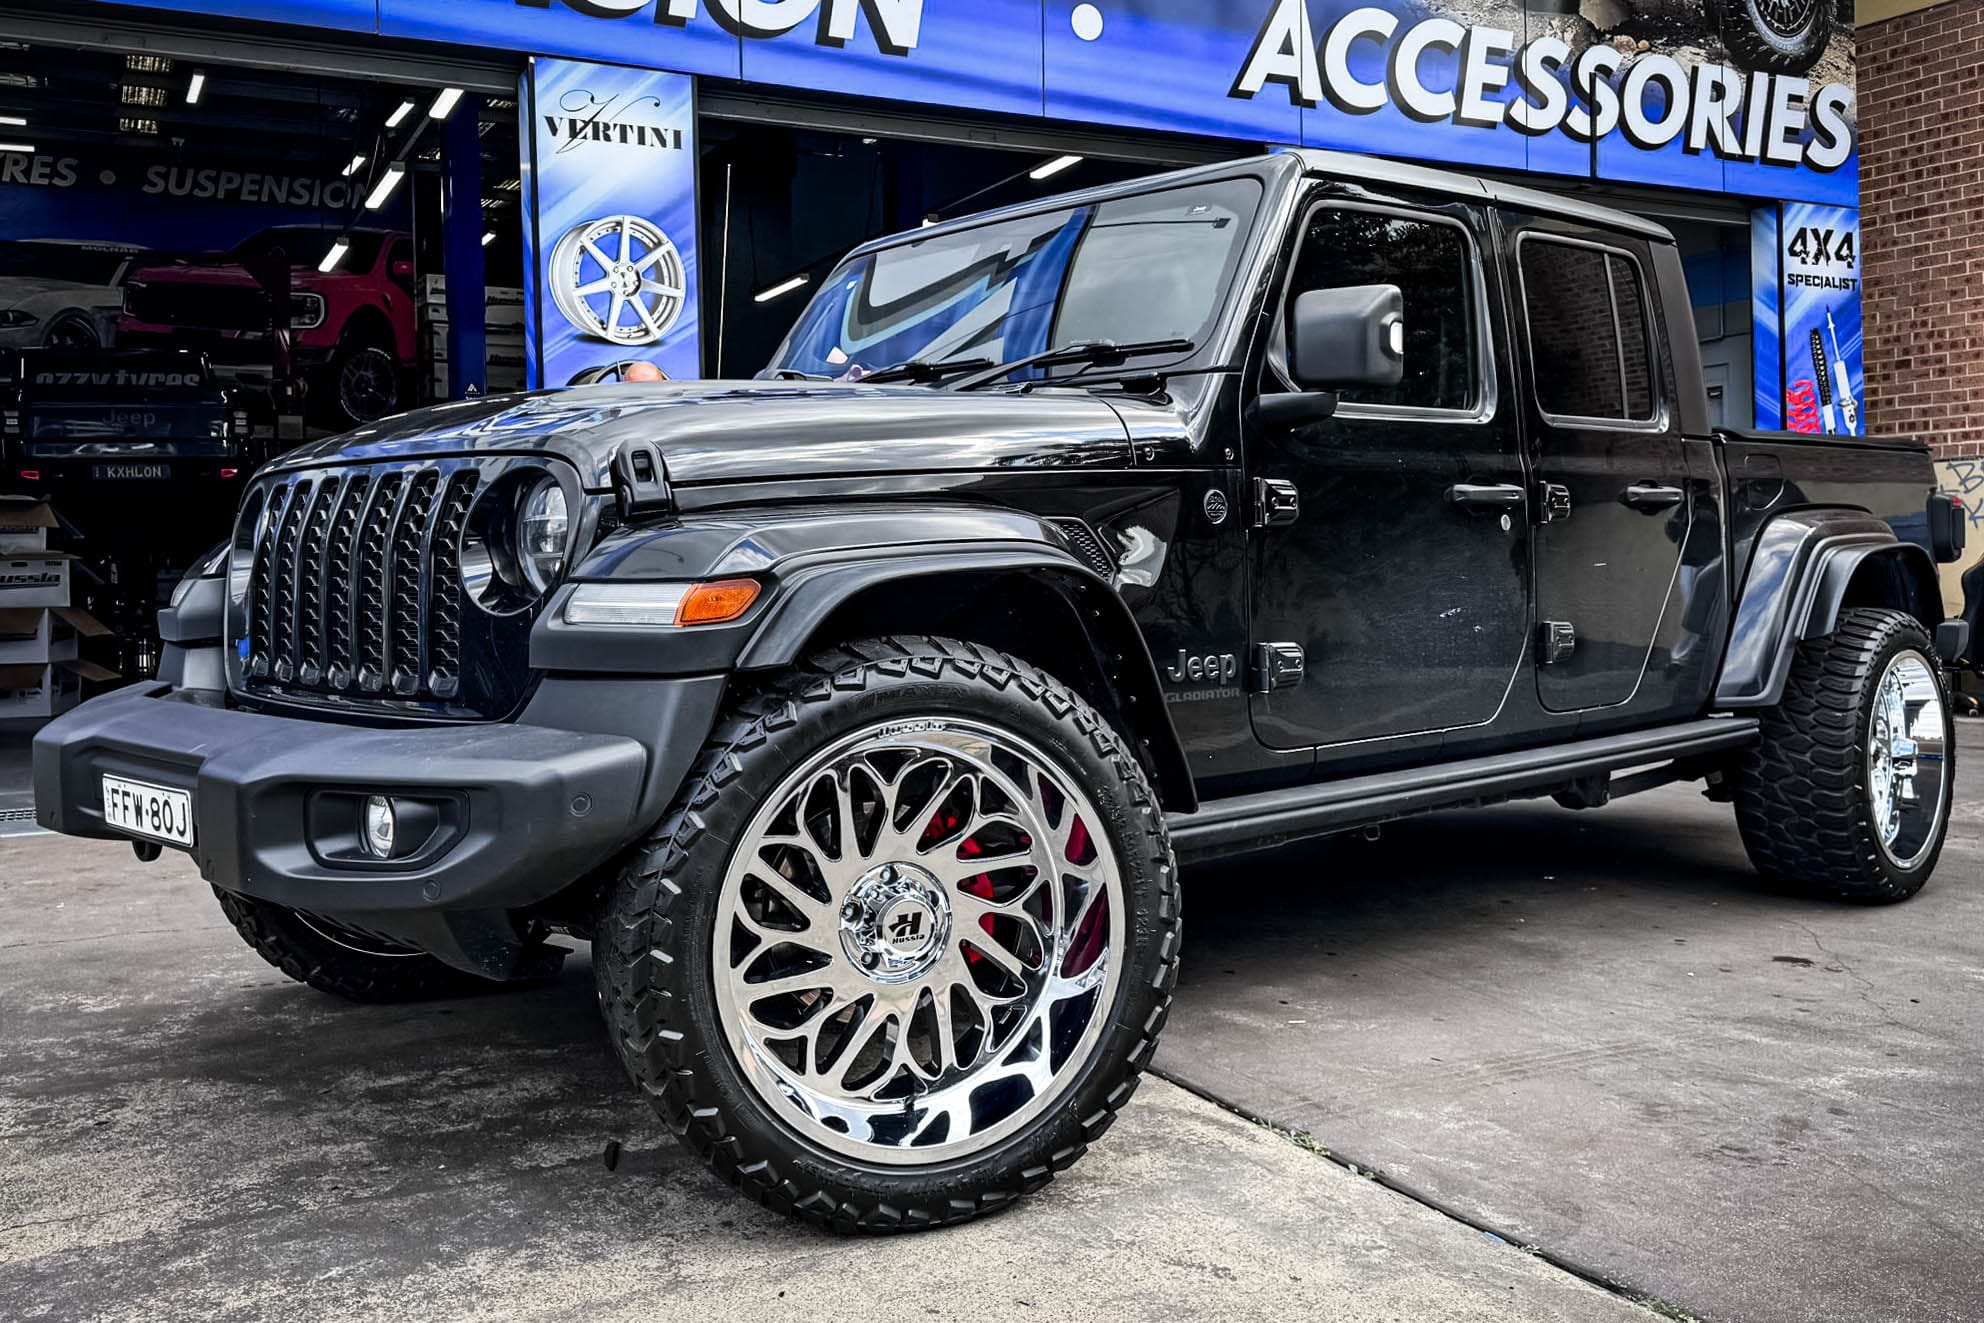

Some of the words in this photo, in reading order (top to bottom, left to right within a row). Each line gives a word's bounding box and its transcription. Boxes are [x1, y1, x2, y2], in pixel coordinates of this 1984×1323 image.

[1230, 0, 1854, 167] ACCESSORIES
[543, 115, 683, 150] VERTINI
[1787, 226, 1856, 269] 4X4
[1787, 272, 1859, 292] SPECIALIST
[103, 407, 156, 428] Jeep
[106, 465, 162, 479] KXHLON
[1167, 648, 1237, 685] Jeep
[1165, 687, 1241, 703] GLADIATOR
